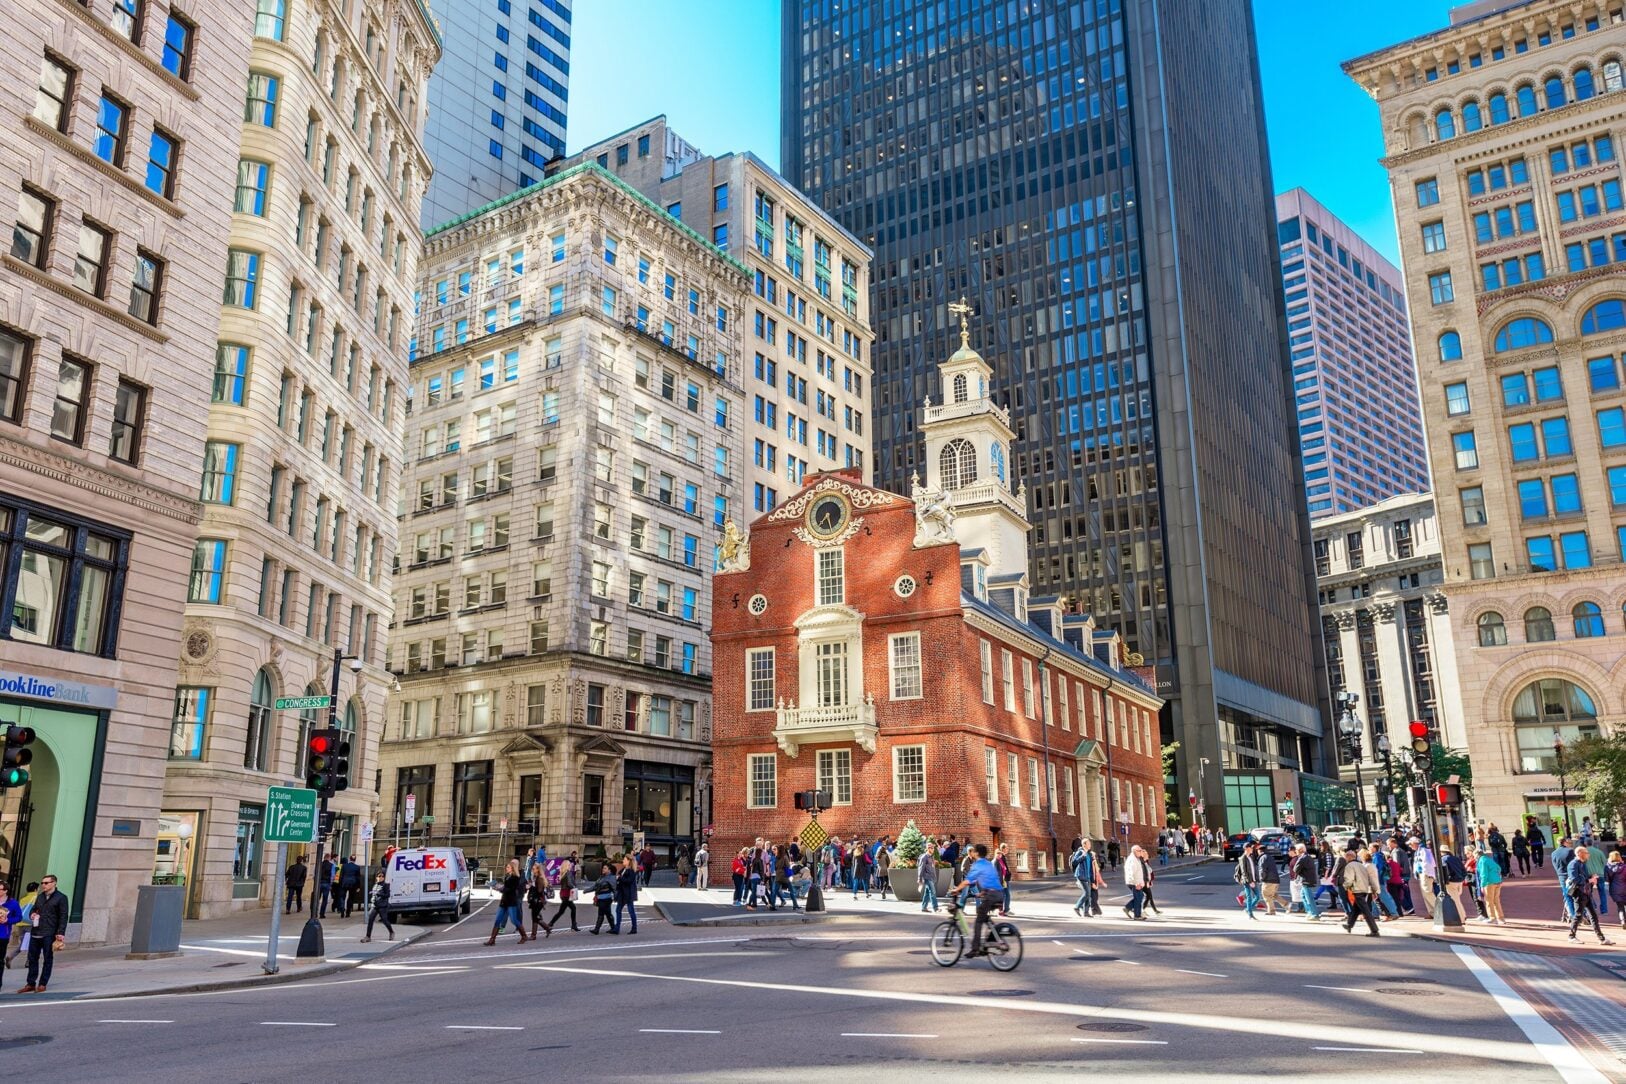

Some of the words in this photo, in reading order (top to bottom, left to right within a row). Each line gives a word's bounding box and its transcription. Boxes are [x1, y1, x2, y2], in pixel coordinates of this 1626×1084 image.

[284, 698, 321, 708] CONGRESS
[275, 792, 291, 801] Station
[291, 801, 313, 810] Downtown
[290, 809, 310, 819] Crossing
[290, 820, 311, 828] Government
[290, 828, 303, 836] Center
[396, 855, 447, 871] FedEx
